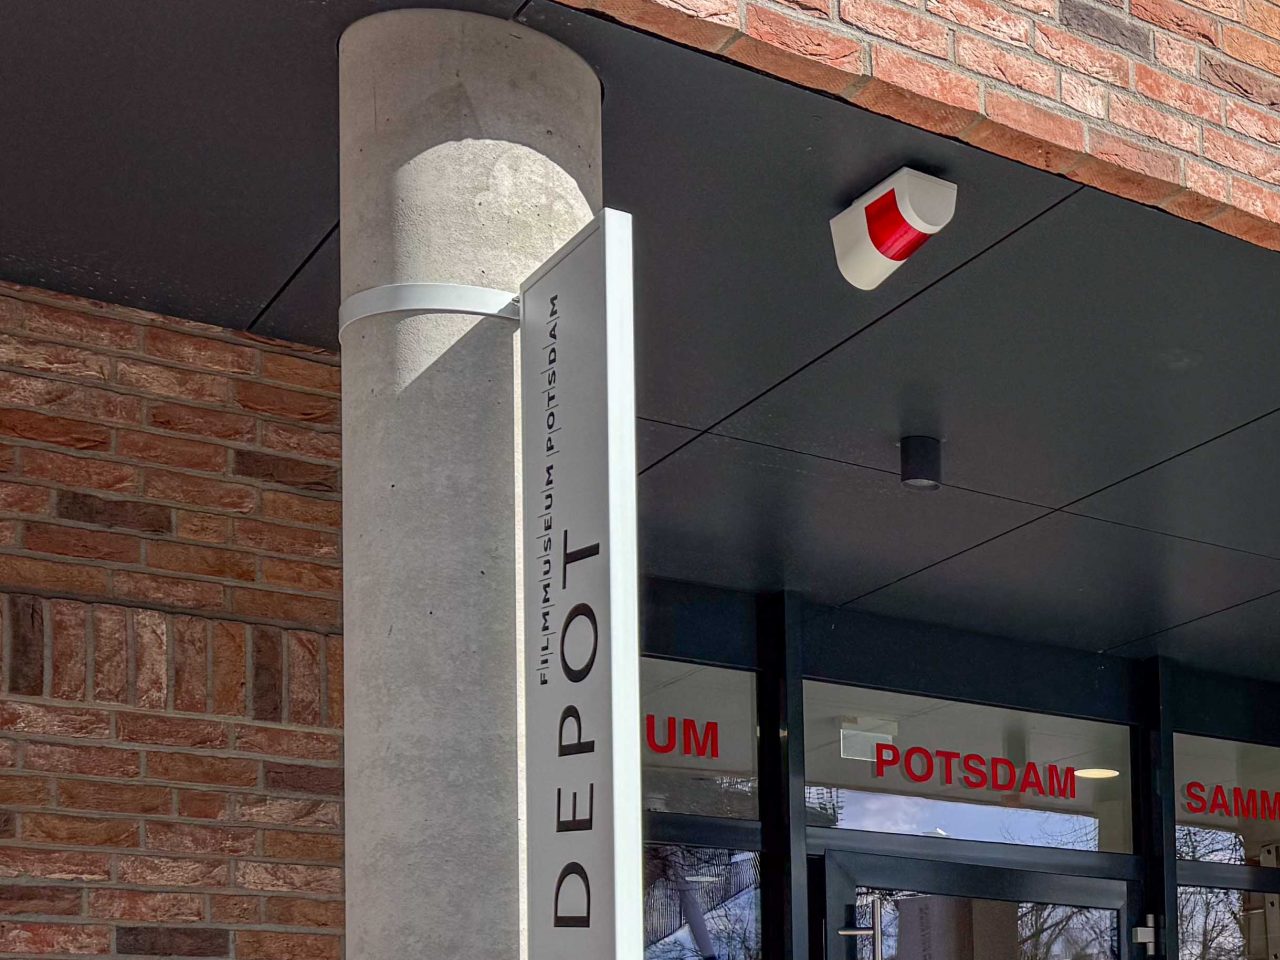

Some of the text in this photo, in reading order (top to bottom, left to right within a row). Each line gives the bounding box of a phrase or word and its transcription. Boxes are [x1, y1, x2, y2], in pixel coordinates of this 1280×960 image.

[539, 294, 559, 686] FILMMUSEUM POTSDAM
[875, 742, 1076, 799] POTSDAM
